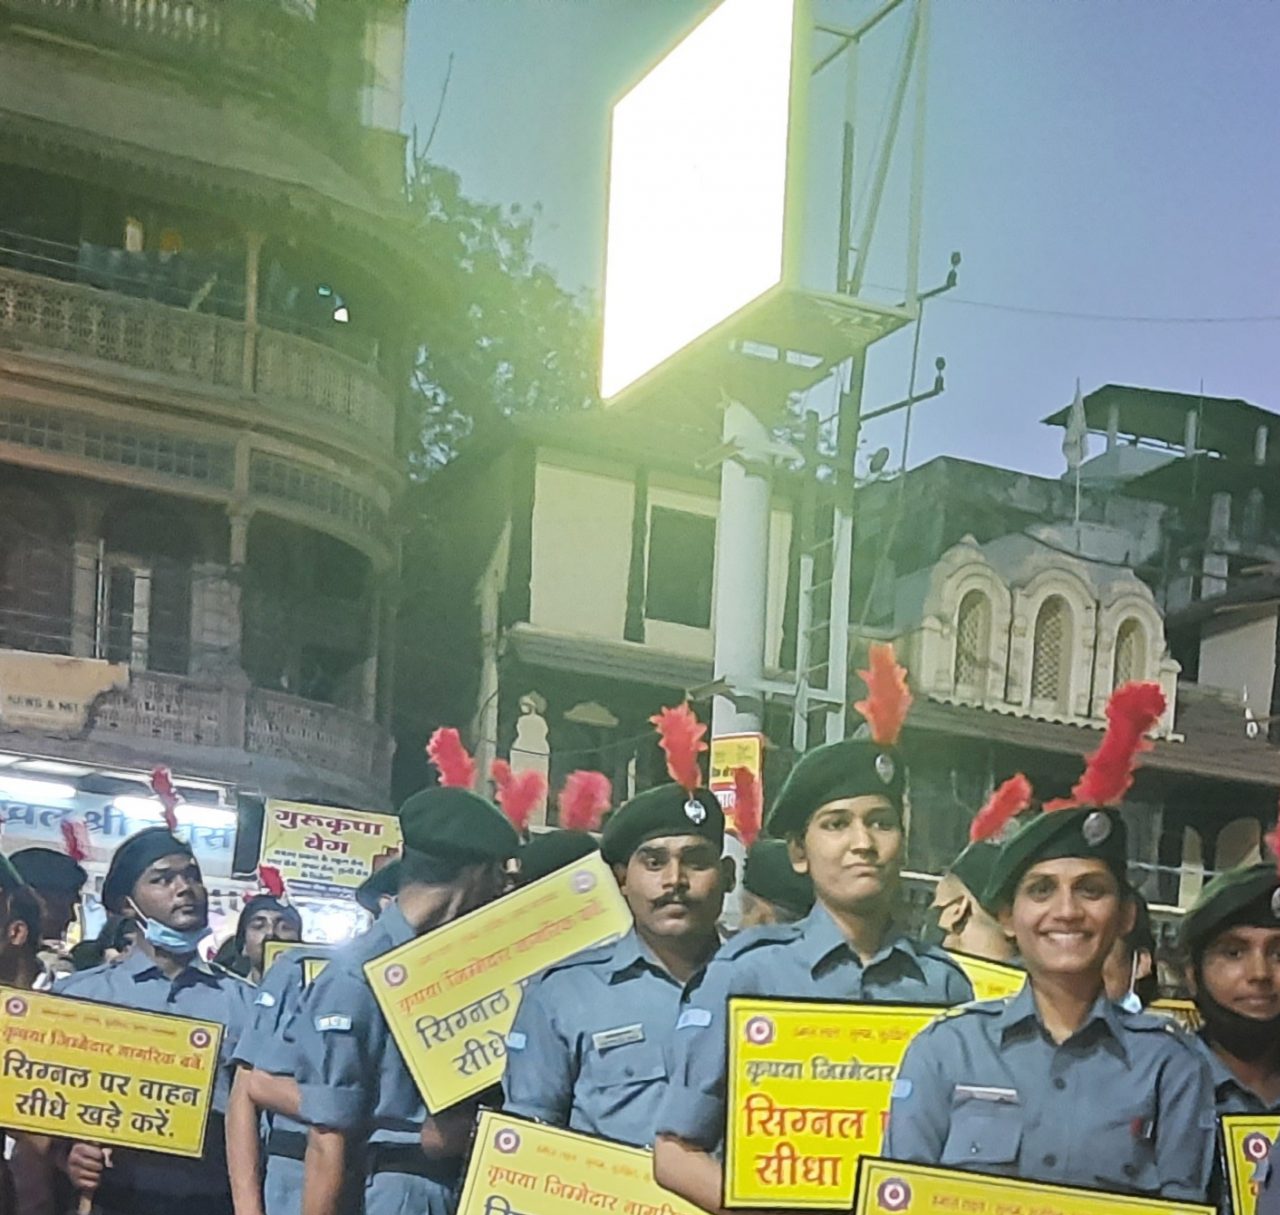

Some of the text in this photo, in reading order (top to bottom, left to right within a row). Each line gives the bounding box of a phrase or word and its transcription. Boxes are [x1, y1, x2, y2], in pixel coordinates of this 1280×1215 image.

[399, 980, 442, 1014] कृपया
[414, 989, 510, 1050] सिग्नल
[3, 1026, 45, 1045] कृपया
[50, 1029, 114, 1055] जिम्मेदार
[118, 1043, 176, 1065] नागरिक
[451, 1030, 507, 1076] सीधे
[3, 1049, 201, 1106] सिग्नल पर वाहन
[745, 1061, 803, 1086] कृपया
[16, 1088, 174, 1137] सीधे खड़े करें.
[743, 1092, 867, 1139] सिग्नल
[487, 1163, 538, 1190] कृपया
[544, 1174, 619, 1210] जिम्मेदार
[754, 1141, 842, 1187] सीधा
